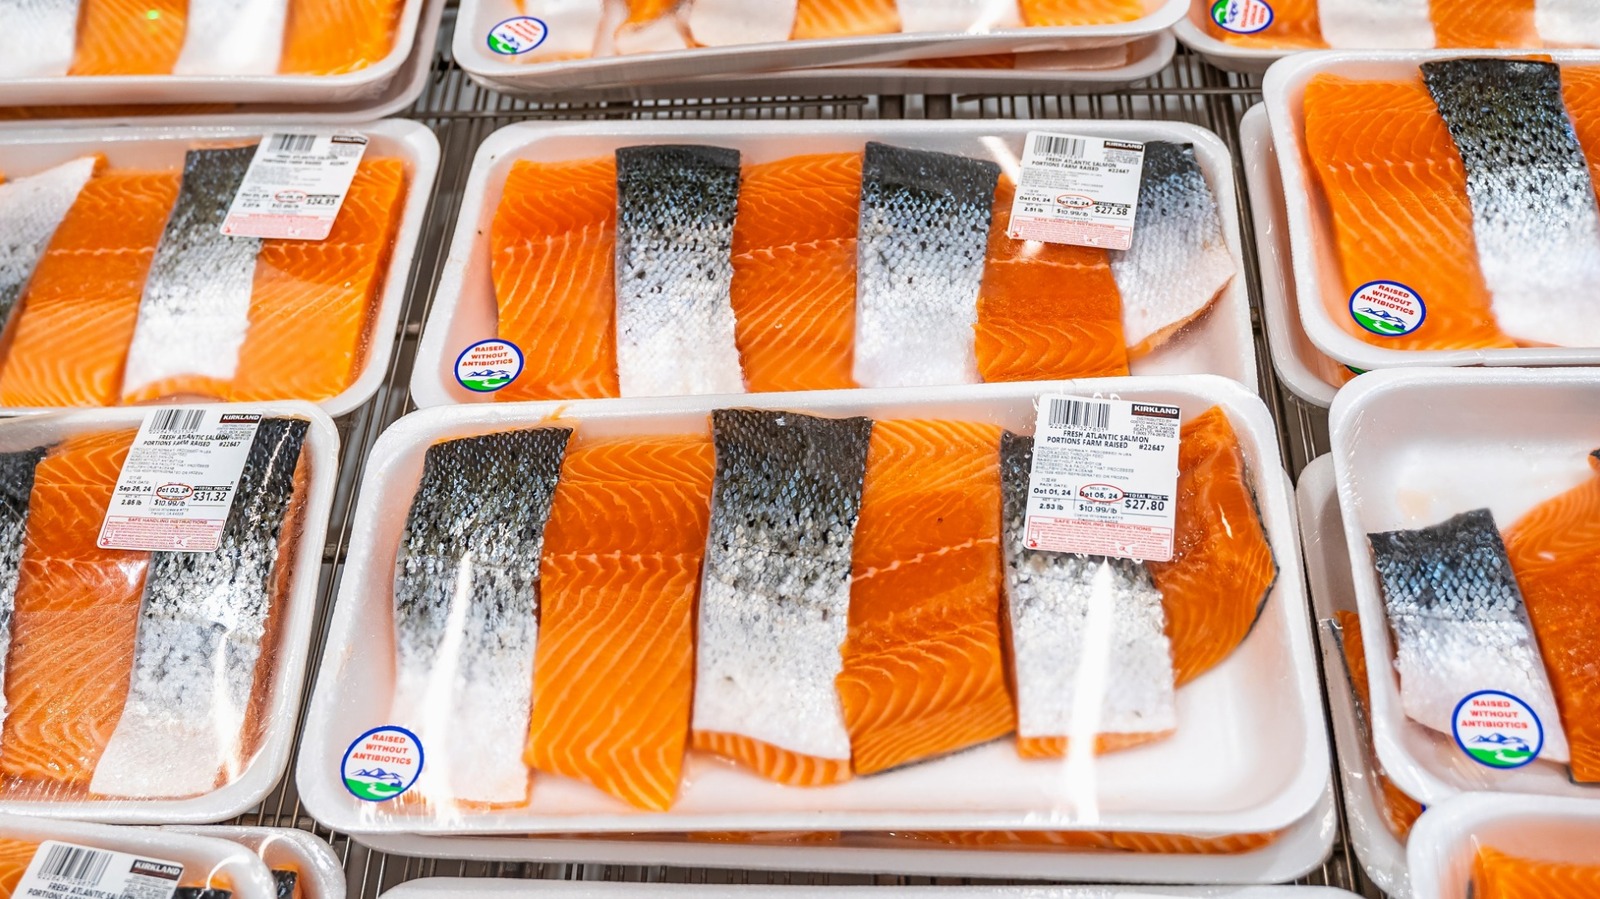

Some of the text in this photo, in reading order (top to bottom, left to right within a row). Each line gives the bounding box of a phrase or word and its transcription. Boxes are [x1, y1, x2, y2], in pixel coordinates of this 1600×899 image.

[1095, 206, 1128, 216] $27.58
[1378, 285, 1410, 298] RAISED
[1372, 290, 1412, 306] WITHOUT
[1360, 294, 1415, 315] ANTIBIOTICS
[462, 358, 513, 366] ANTIBIOTICS
[1134, 404, 1178, 415] KIRKLAND
[1063, 430, 1149, 443] FRESH ATLANTIC SALMON
[1047, 436, 1081, 445] PORTIONS
[1082, 439, 1102, 447] FARM
[1104, 440, 1128, 449] RAISED
[193, 492, 227, 501] $31.32
[154, 499, 186, 507] $10.99/lb
[1125, 499, 1165, 511] $27.80
[1079, 504, 1117, 514] $10.99/lb
[1105, 523, 1152, 531] INSTRUCTIONS
[1473, 700, 1511, 708] RAISED
[1470, 710, 1518, 718] WITHOUT
[1461, 720, 1528, 729] ANTIBIOTICS
[372, 734, 406, 744] RAISED
[366, 744, 408, 754] WITHOUT
[353, 752, 412, 765] ANTIBIOTICS
[134, 861, 181, 876] KIRKLAND
[48, 882, 69, 892] FRESH
[70, 886, 106, 899] ATLANTIC
